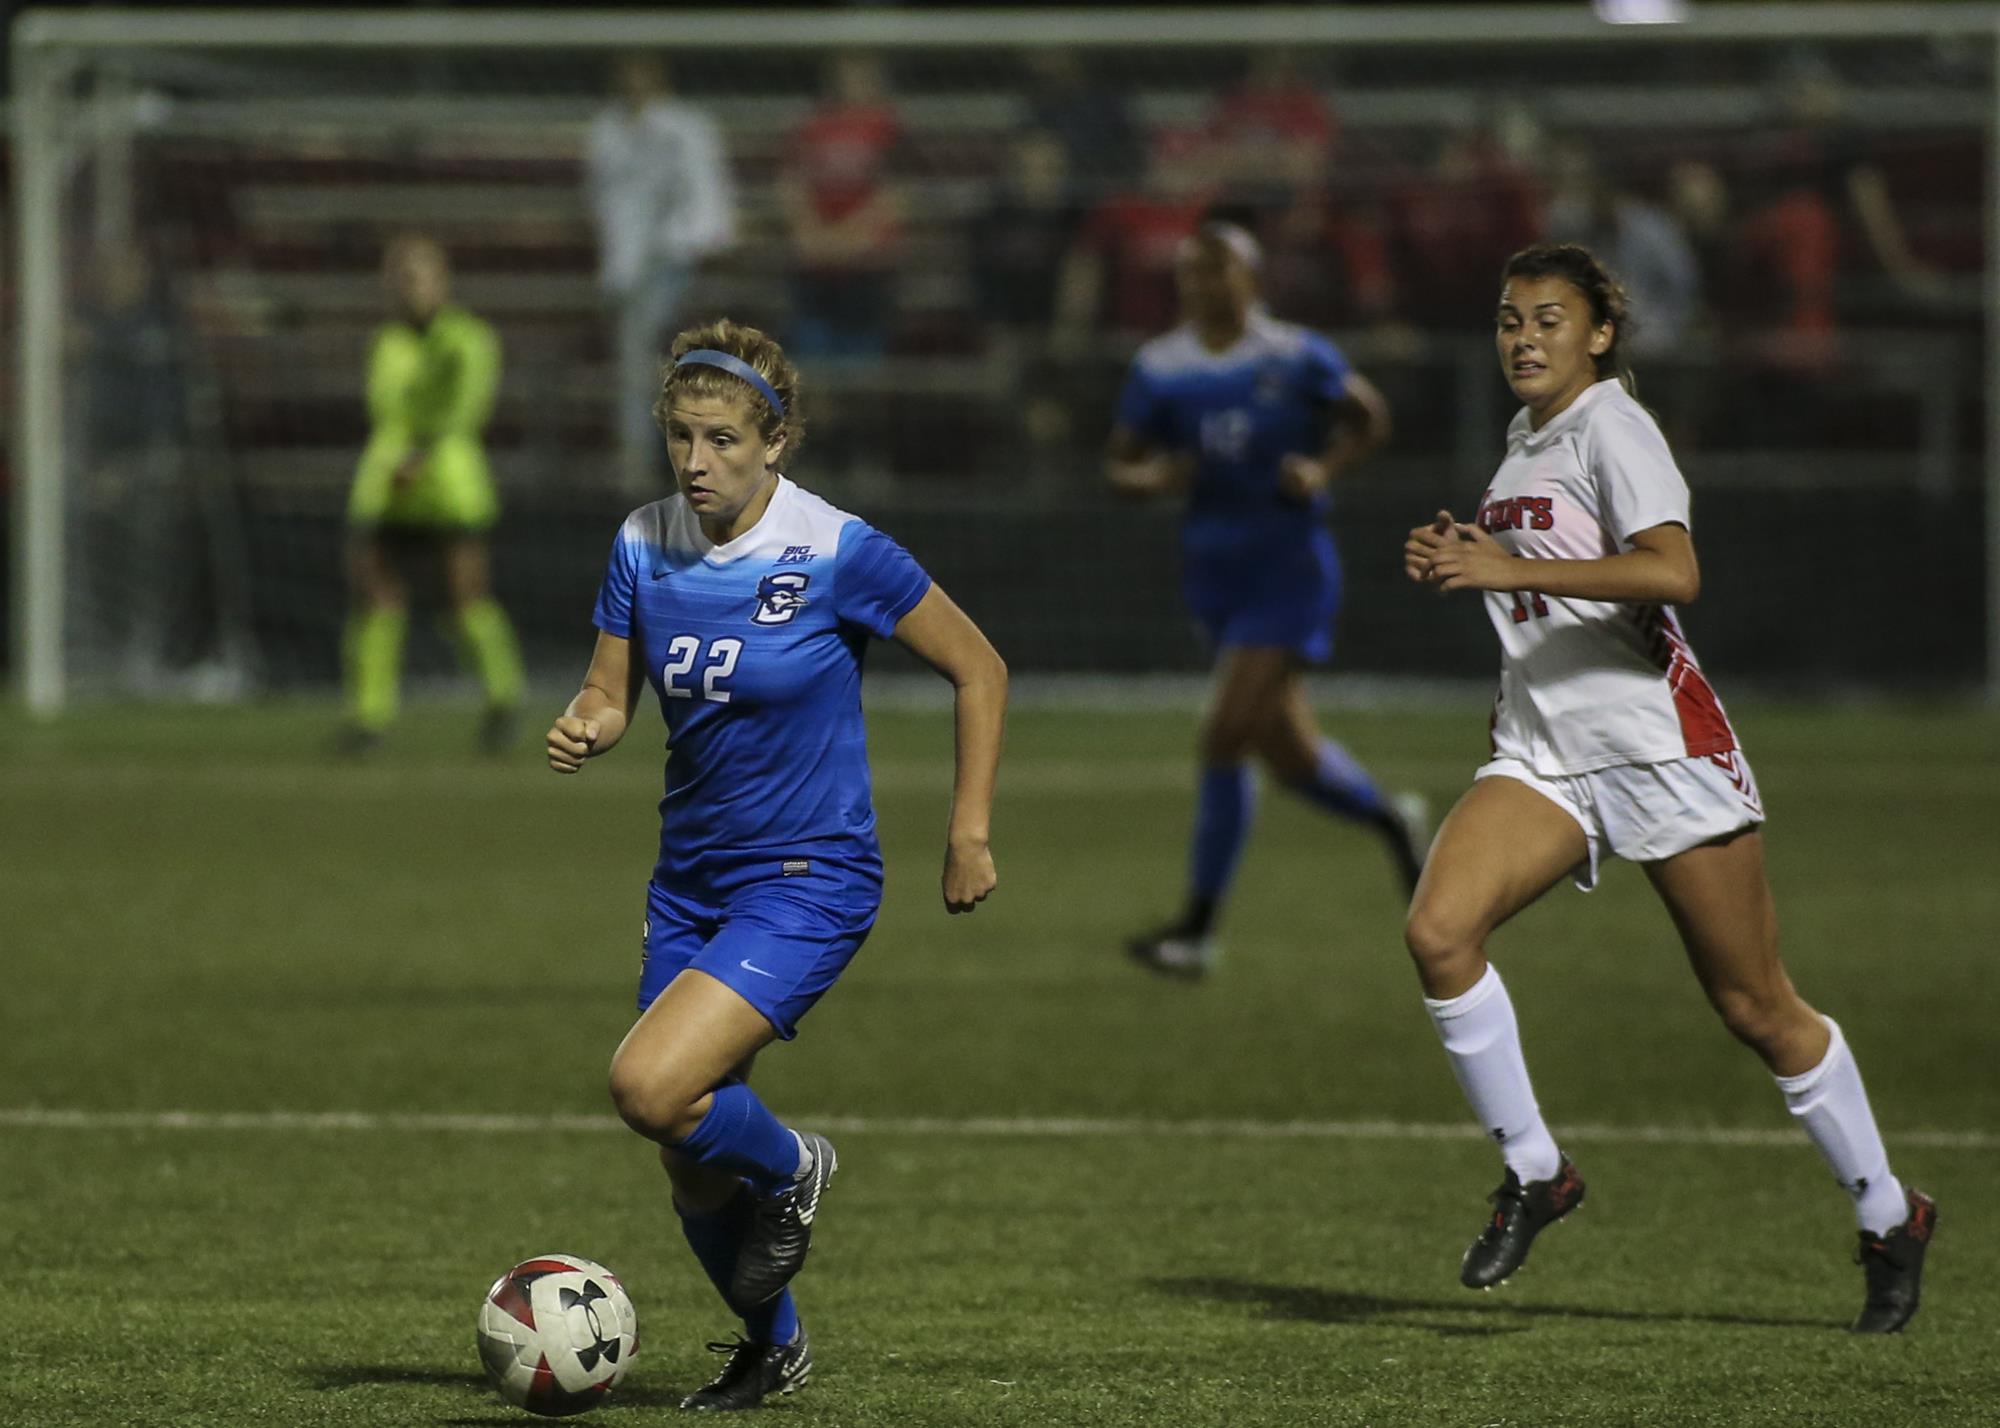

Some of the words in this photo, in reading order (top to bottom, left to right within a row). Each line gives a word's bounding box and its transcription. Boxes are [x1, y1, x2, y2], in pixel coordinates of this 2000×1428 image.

[1478, 489, 1553, 533] OHN'S
[776, 554, 818, 563] EAST
[783, 545, 812, 554] BIG
[662, 635, 744, 703] 22
